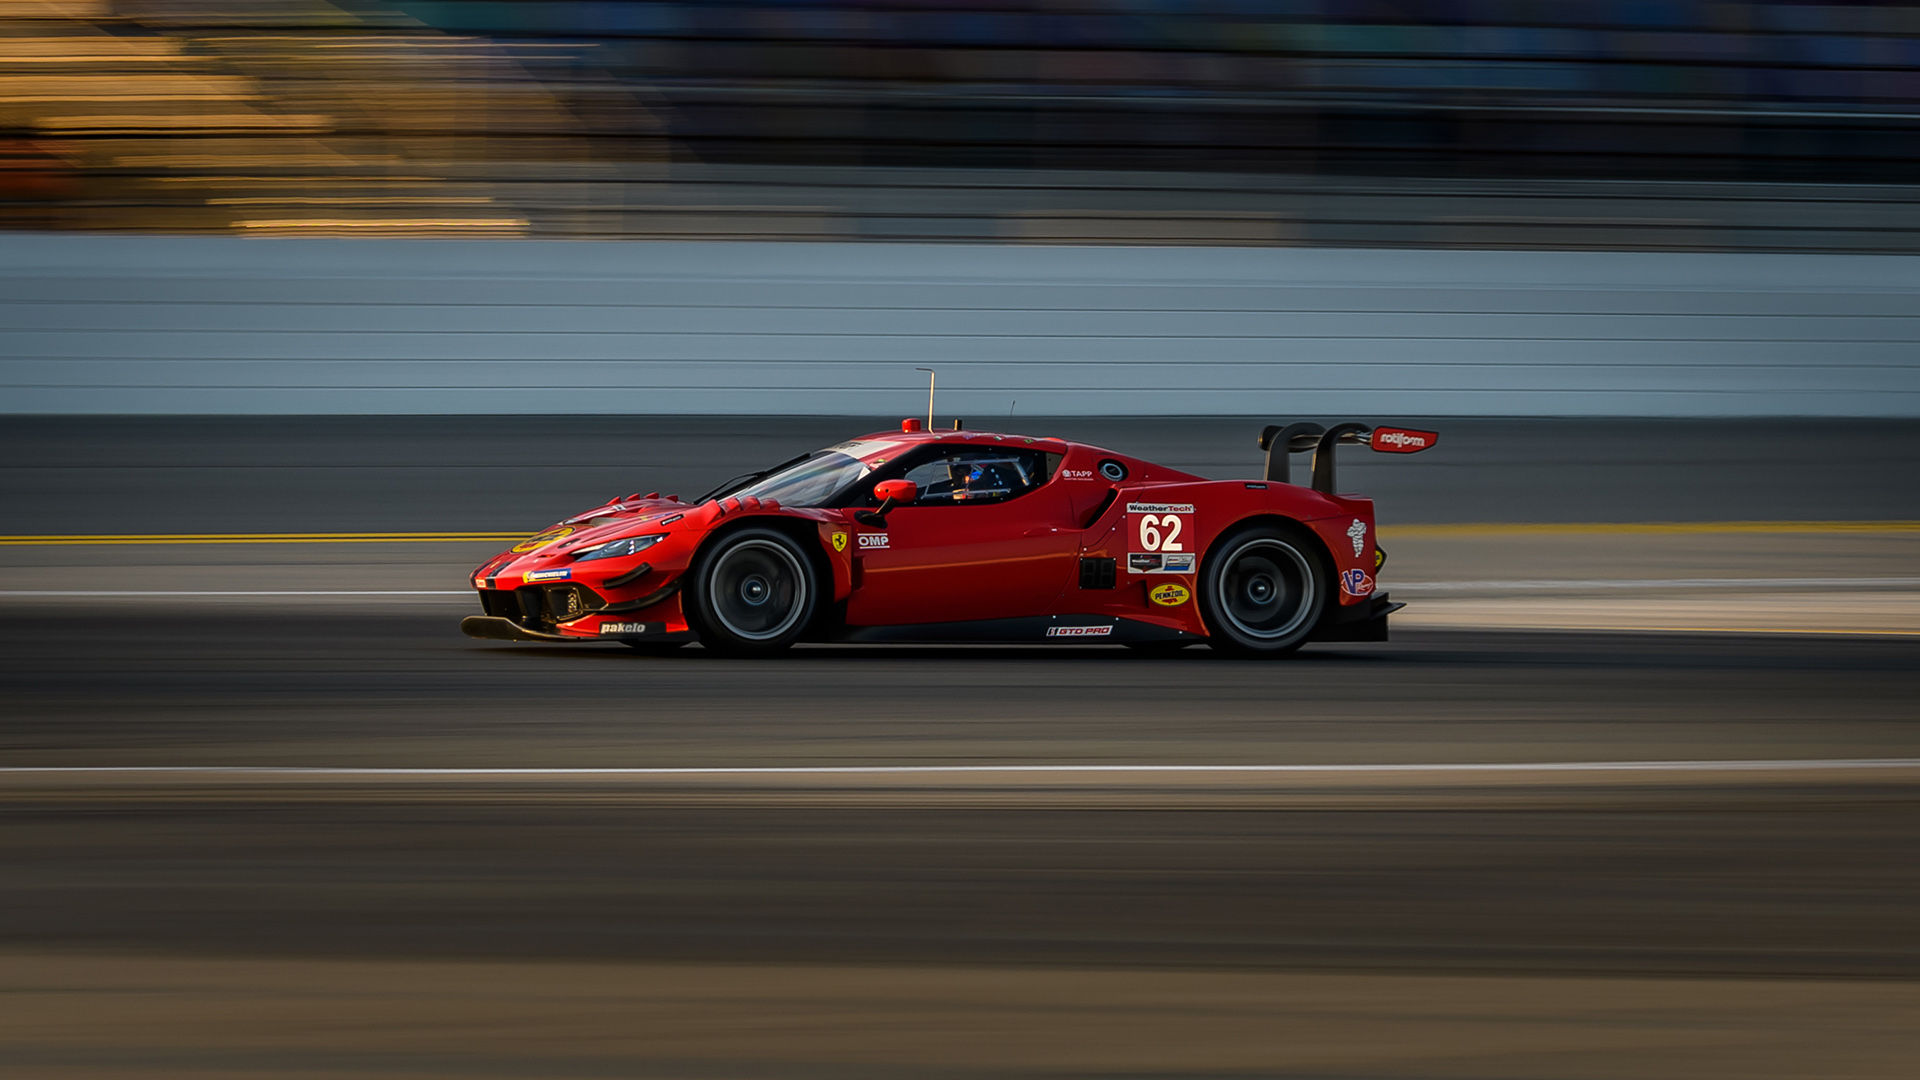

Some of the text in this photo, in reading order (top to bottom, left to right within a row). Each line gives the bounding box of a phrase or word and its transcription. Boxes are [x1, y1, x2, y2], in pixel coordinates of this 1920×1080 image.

[1380, 433, 1425, 448] rotiform
[1129, 504, 1192, 512] WeatherTech
[1140, 514, 1183, 552] 62
[858, 536, 889, 546] OMP
[1342, 569, 1366, 595] VP
[600, 622, 646, 634] pakelo
